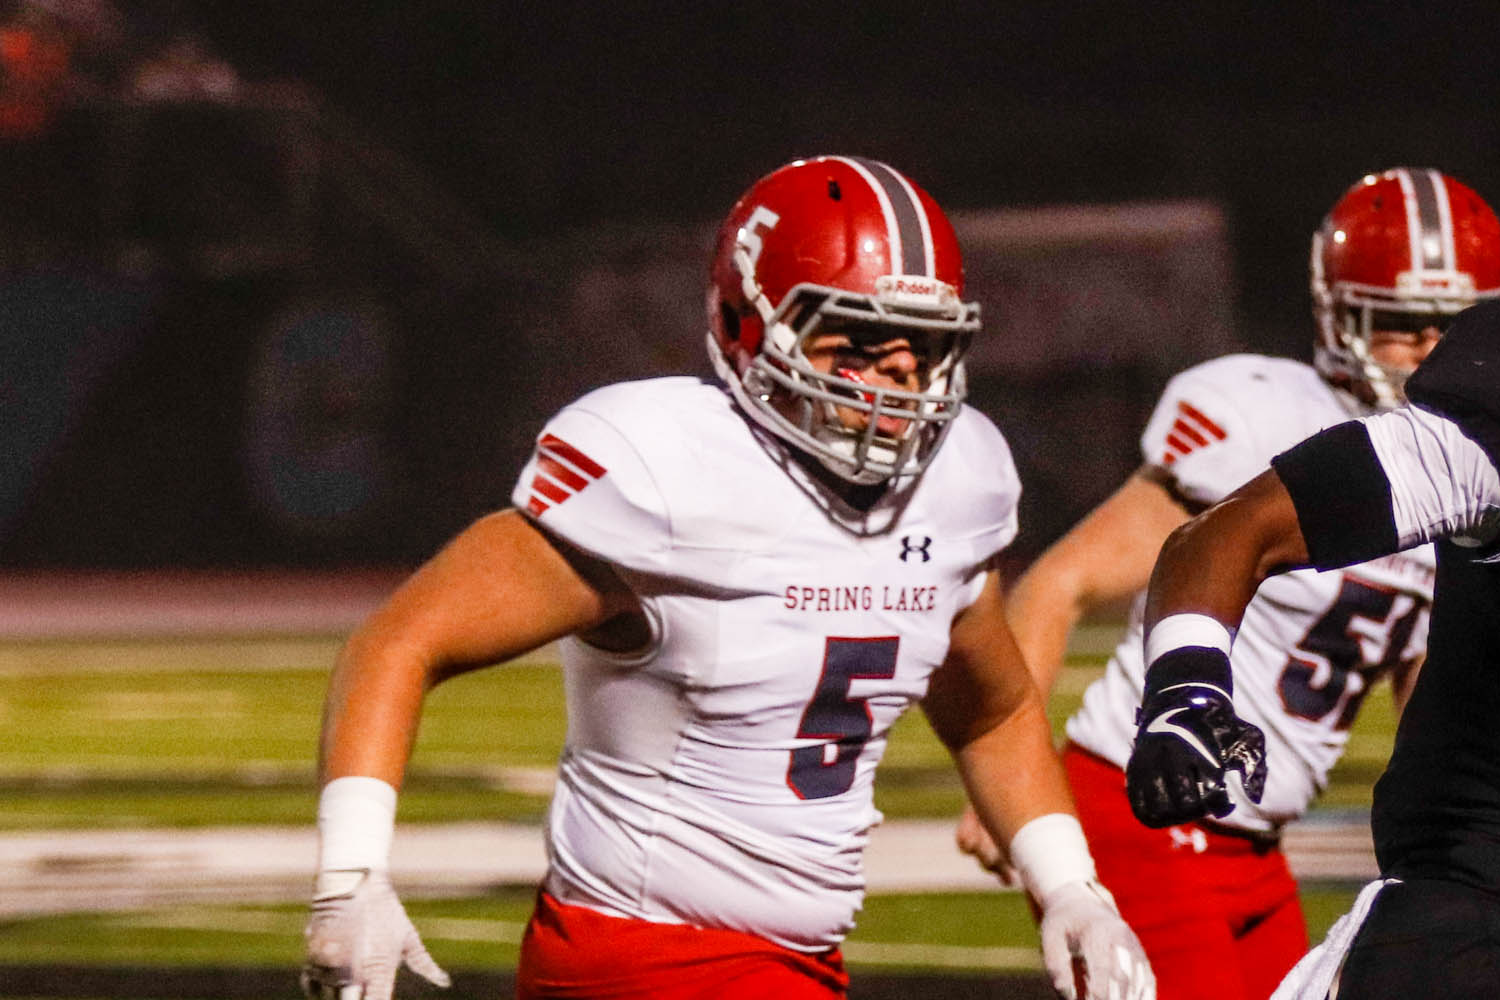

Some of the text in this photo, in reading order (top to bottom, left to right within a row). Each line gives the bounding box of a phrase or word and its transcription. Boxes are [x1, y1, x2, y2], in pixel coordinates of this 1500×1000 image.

[783, 585, 938, 612] SPRING LAKE
[785, 635, 900, 801] 5
